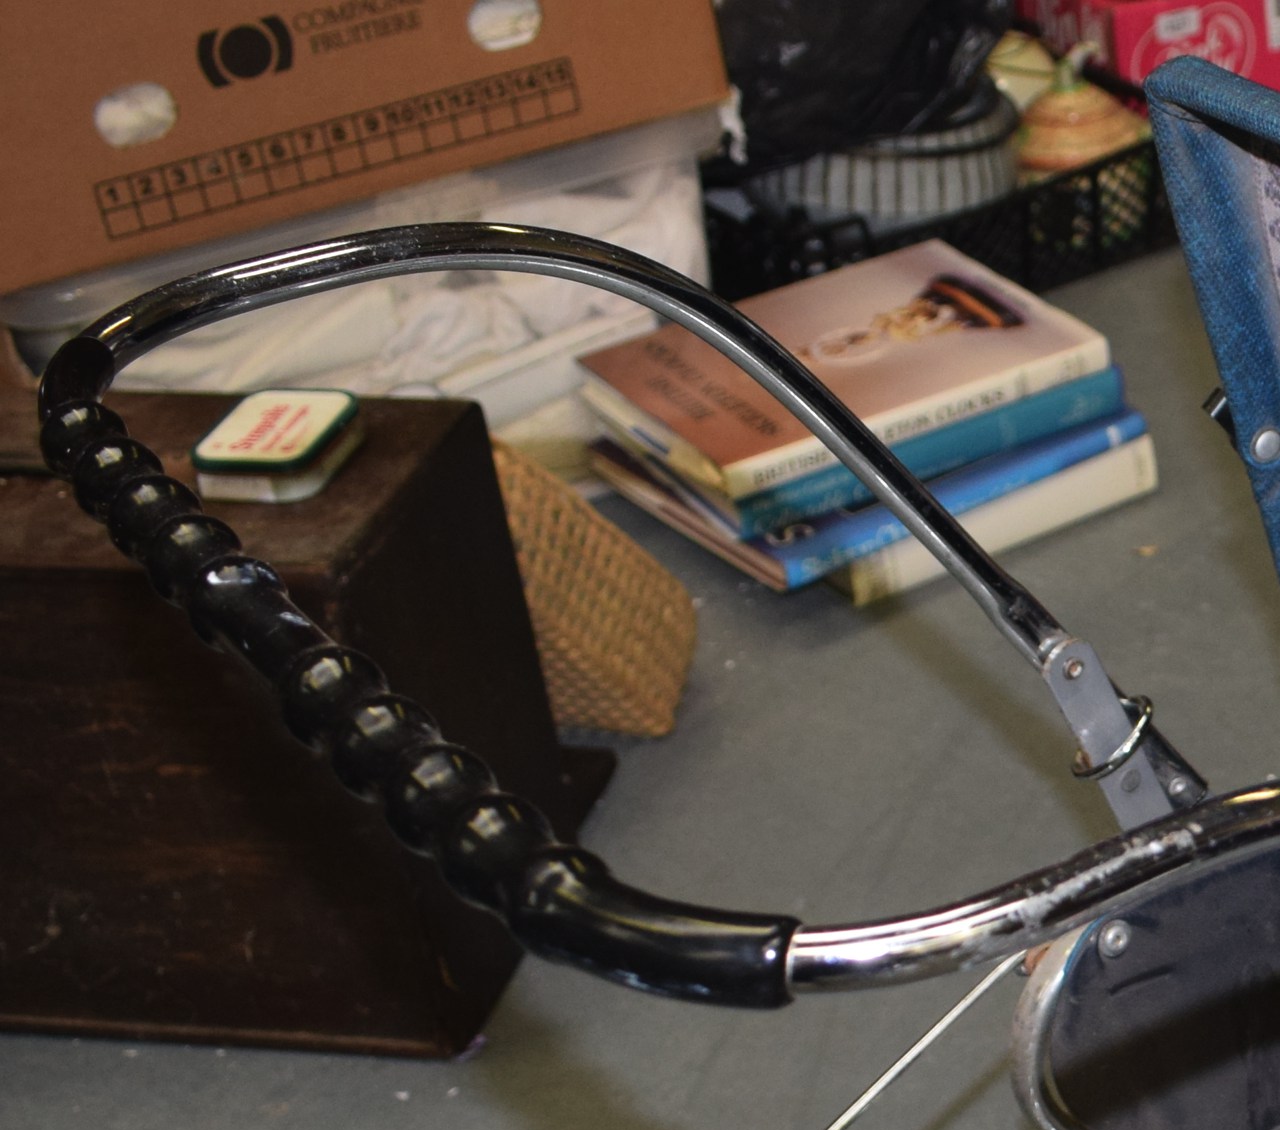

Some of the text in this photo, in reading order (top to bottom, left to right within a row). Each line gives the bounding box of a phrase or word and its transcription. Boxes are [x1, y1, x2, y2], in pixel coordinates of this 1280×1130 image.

[106, 186, 118, 201] 1
[139, 176, 153, 195] 2
[174, 168, 187, 185] 3
[238, 151, 253, 168] 5
[270, 142, 285, 159] 6
[302, 132, 314, 149] 7
[331, 125, 346, 142] 8
[364, 114, 379, 132] 9
[421, 99, 444, 116] 11
[451, 88, 476, 107] 12
[514, 73, 538, 91] 14
